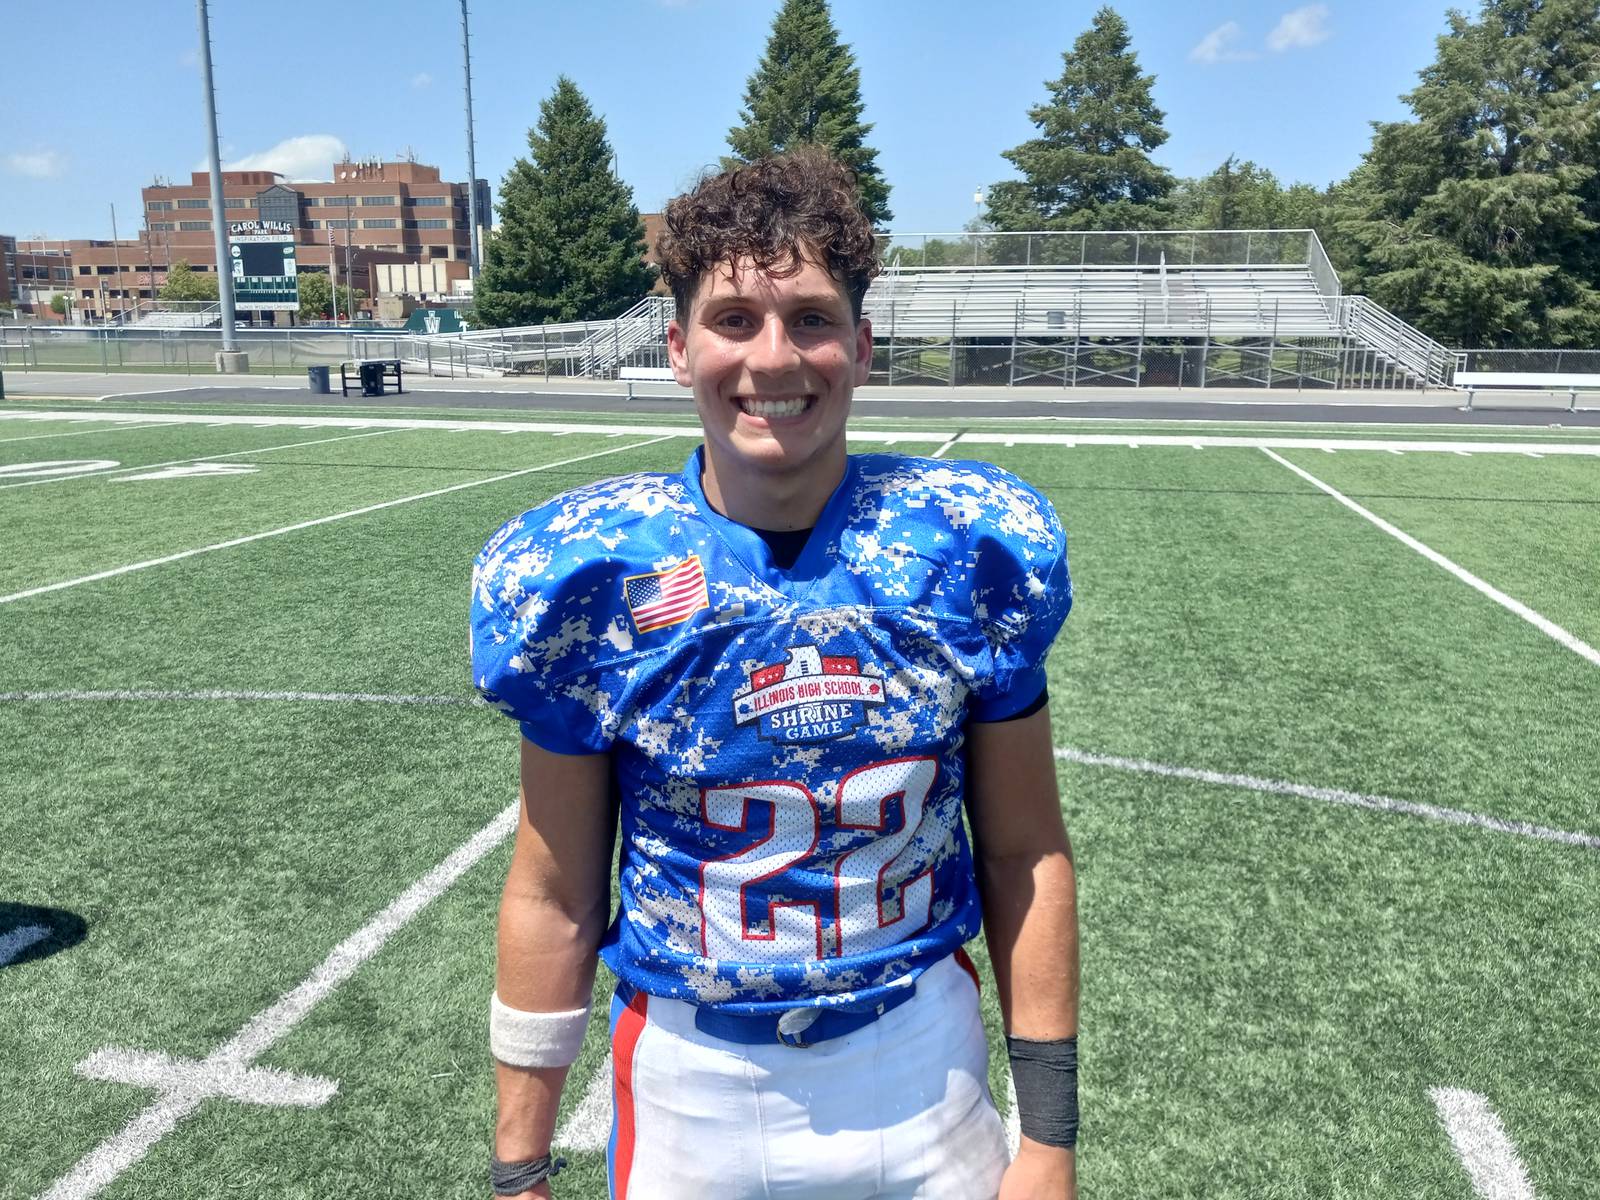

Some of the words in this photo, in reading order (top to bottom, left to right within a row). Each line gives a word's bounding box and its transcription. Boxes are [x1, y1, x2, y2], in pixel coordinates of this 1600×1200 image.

[231, 221, 259, 233] CAROL
[262, 220, 291, 232] WILLIS
[753, 686, 796, 712] ILLINOIS
[798, 682, 821, 699] HIGH
[825, 681, 864, 696] SCHOOL
[770, 702, 853, 729] SHRINE
[785, 720, 843, 740] GAME
[699, 755, 938, 961] 22
